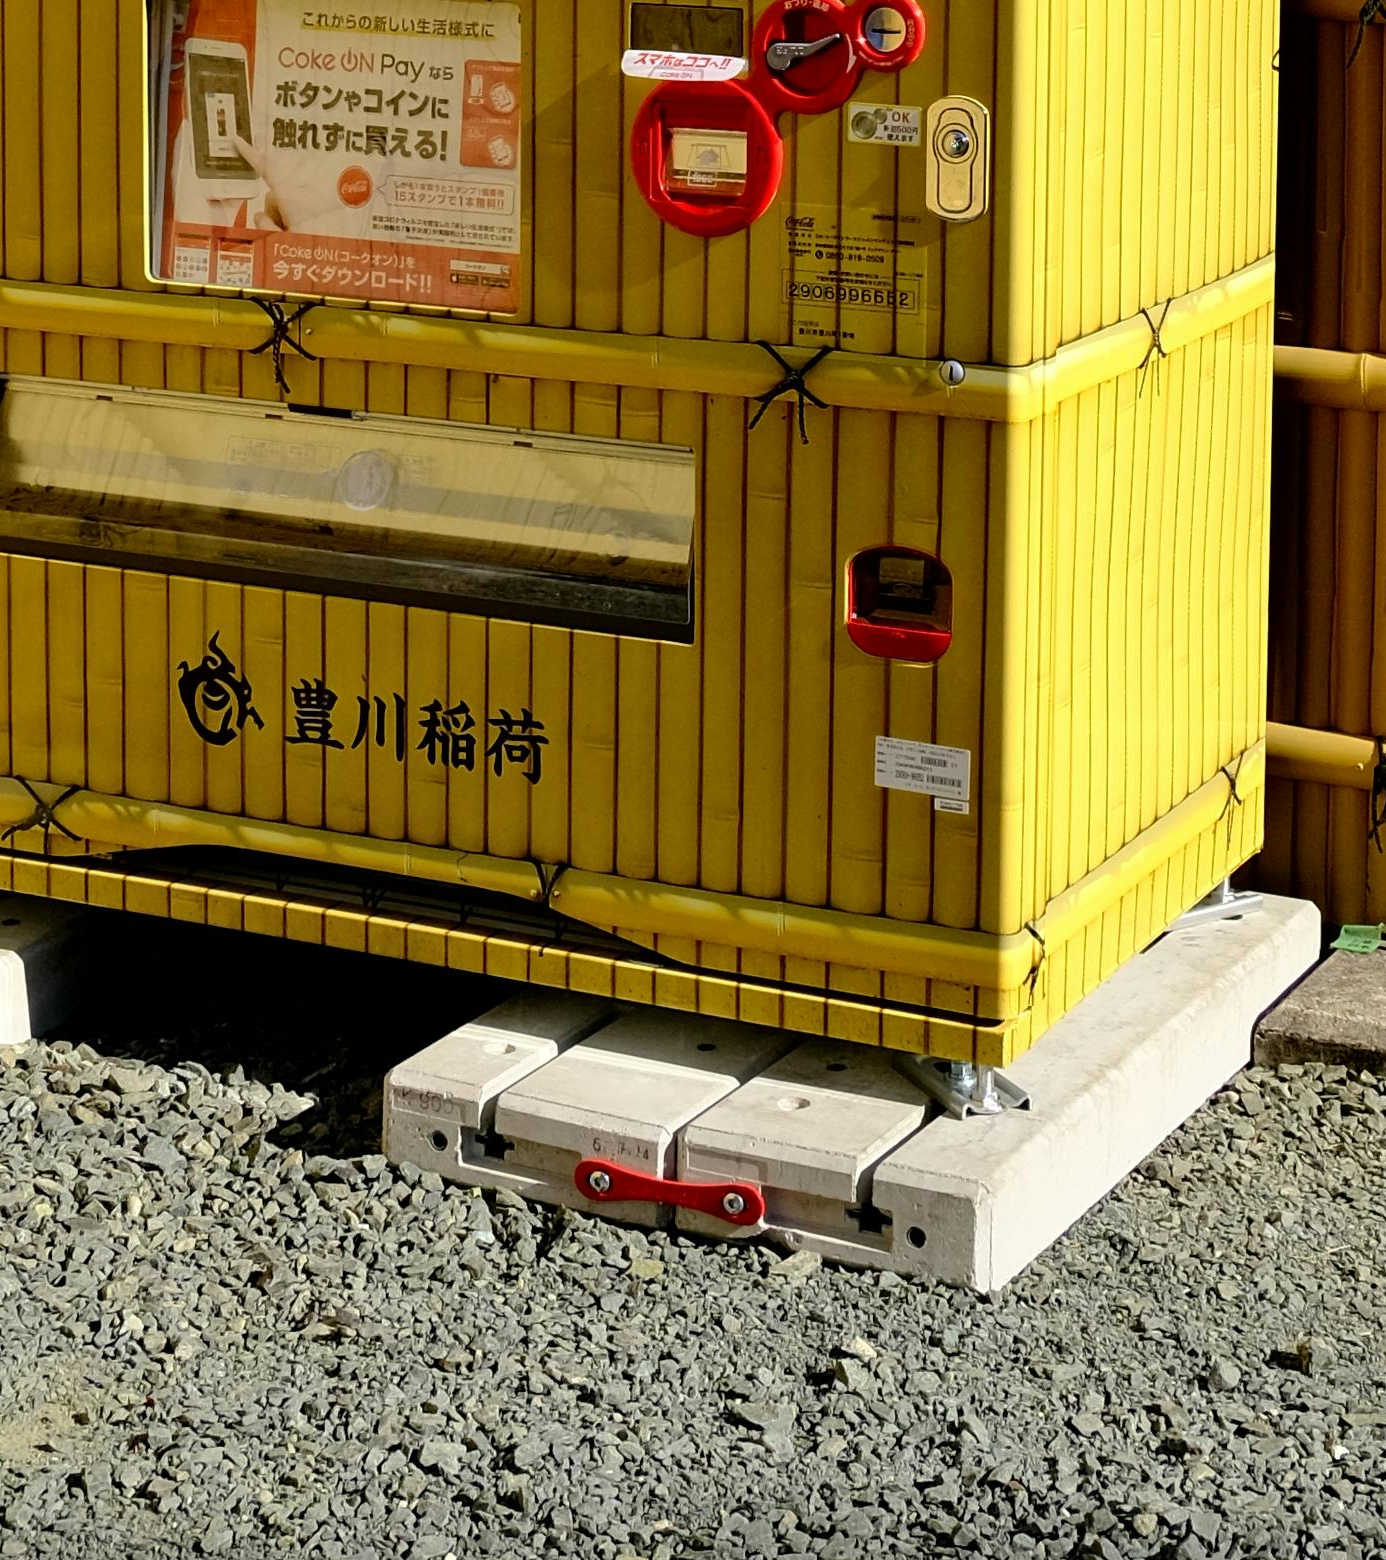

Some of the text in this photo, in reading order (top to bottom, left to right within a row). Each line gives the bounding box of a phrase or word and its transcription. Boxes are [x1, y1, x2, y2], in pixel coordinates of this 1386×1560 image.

[301, 11, 495, 38] これからの新しい生活様式に
[279, 46, 335, 71] Coke
[381, 56, 424, 84] Pay
[429, 66, 453, 80] なら
[275, 81, 449, 120] ボタンやコインに
[892, 112, 910, 124] OK
[285, 678, 550, 784] 豊川稲荷
